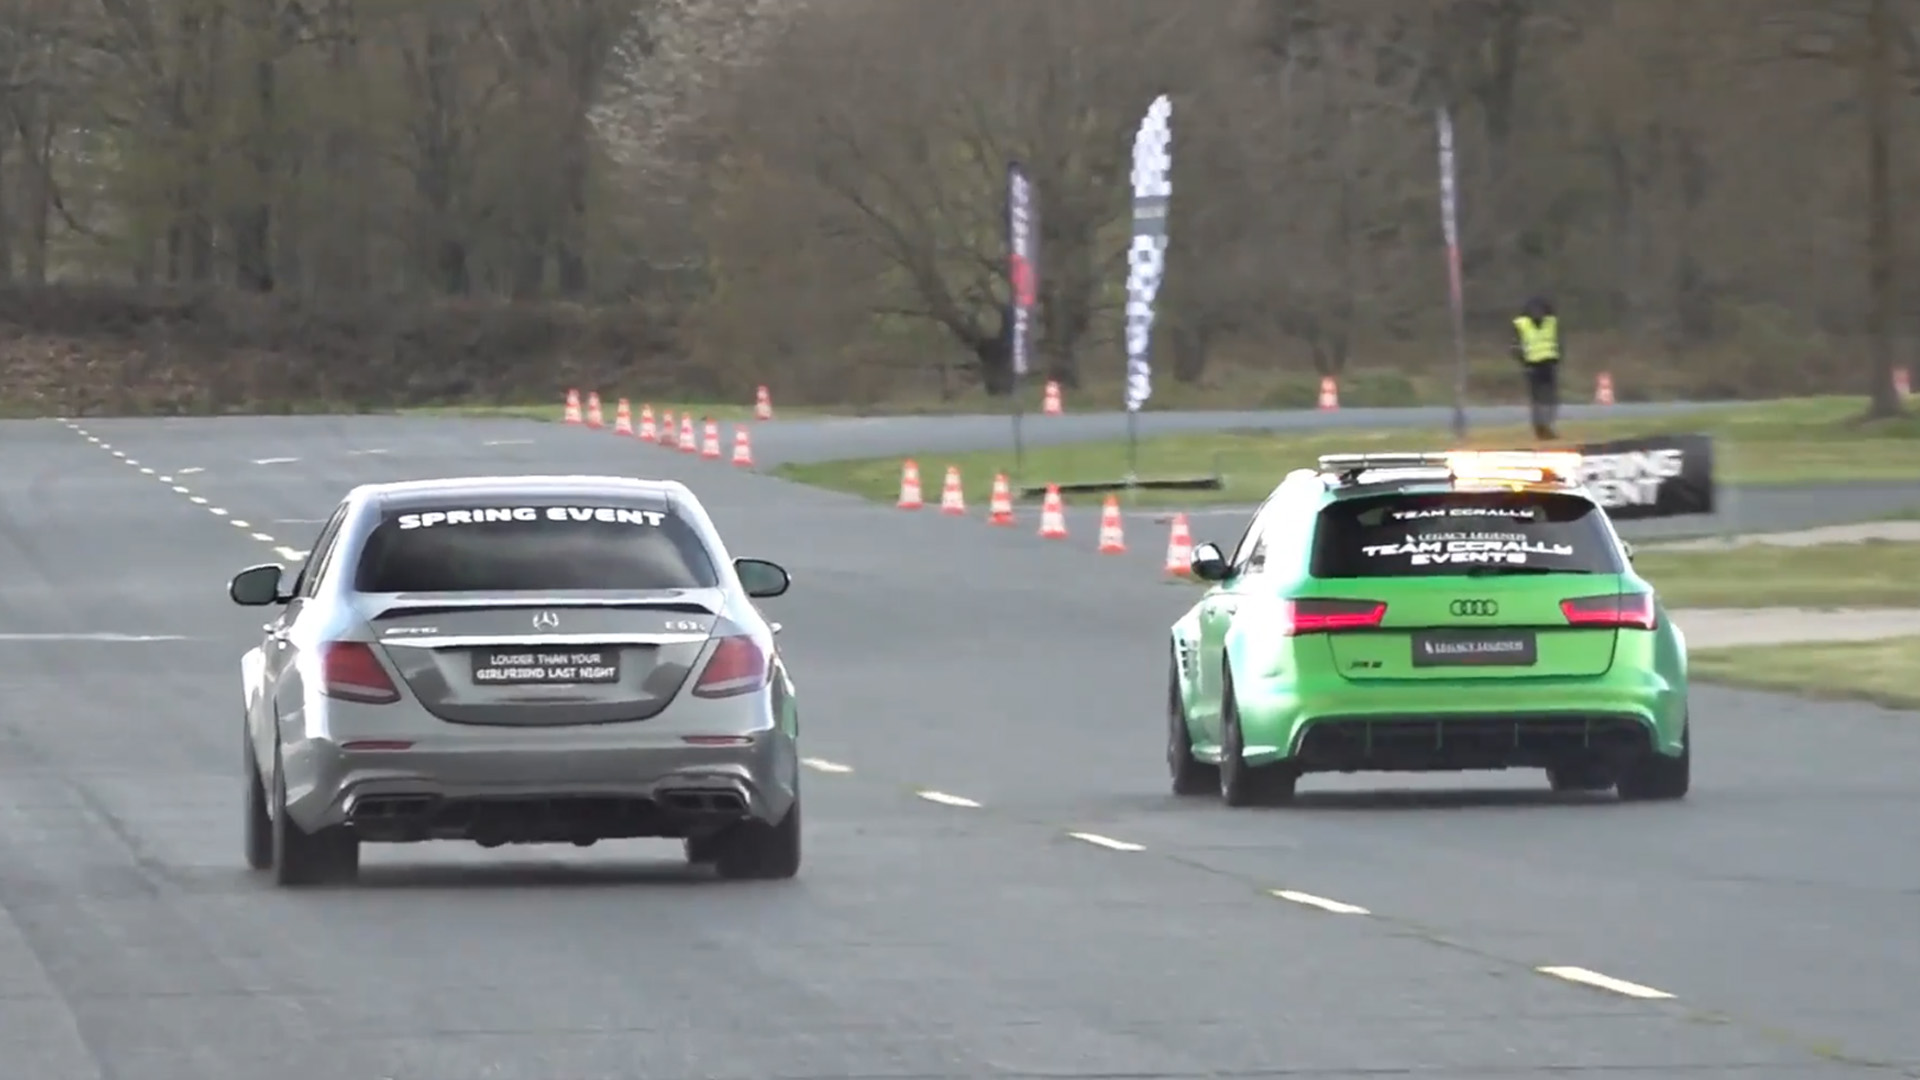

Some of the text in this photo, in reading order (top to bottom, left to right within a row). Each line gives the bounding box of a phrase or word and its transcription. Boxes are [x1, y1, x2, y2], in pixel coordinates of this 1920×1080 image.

[1583, 450, 1683, 479] PRING
[398, 507, 666, 529] SPRING EVENT
[1393, 510, 1446, 520] TEAM
[1362, 541, 1573, 557] TEAM CCRALLY
[1411, 552, 1527, 565] EVENTS
[490, 653, 601, 665] LOUDER THAN YOUR
[476, 667, 616, 679] GIRLFRIEND LAST NIGHT
